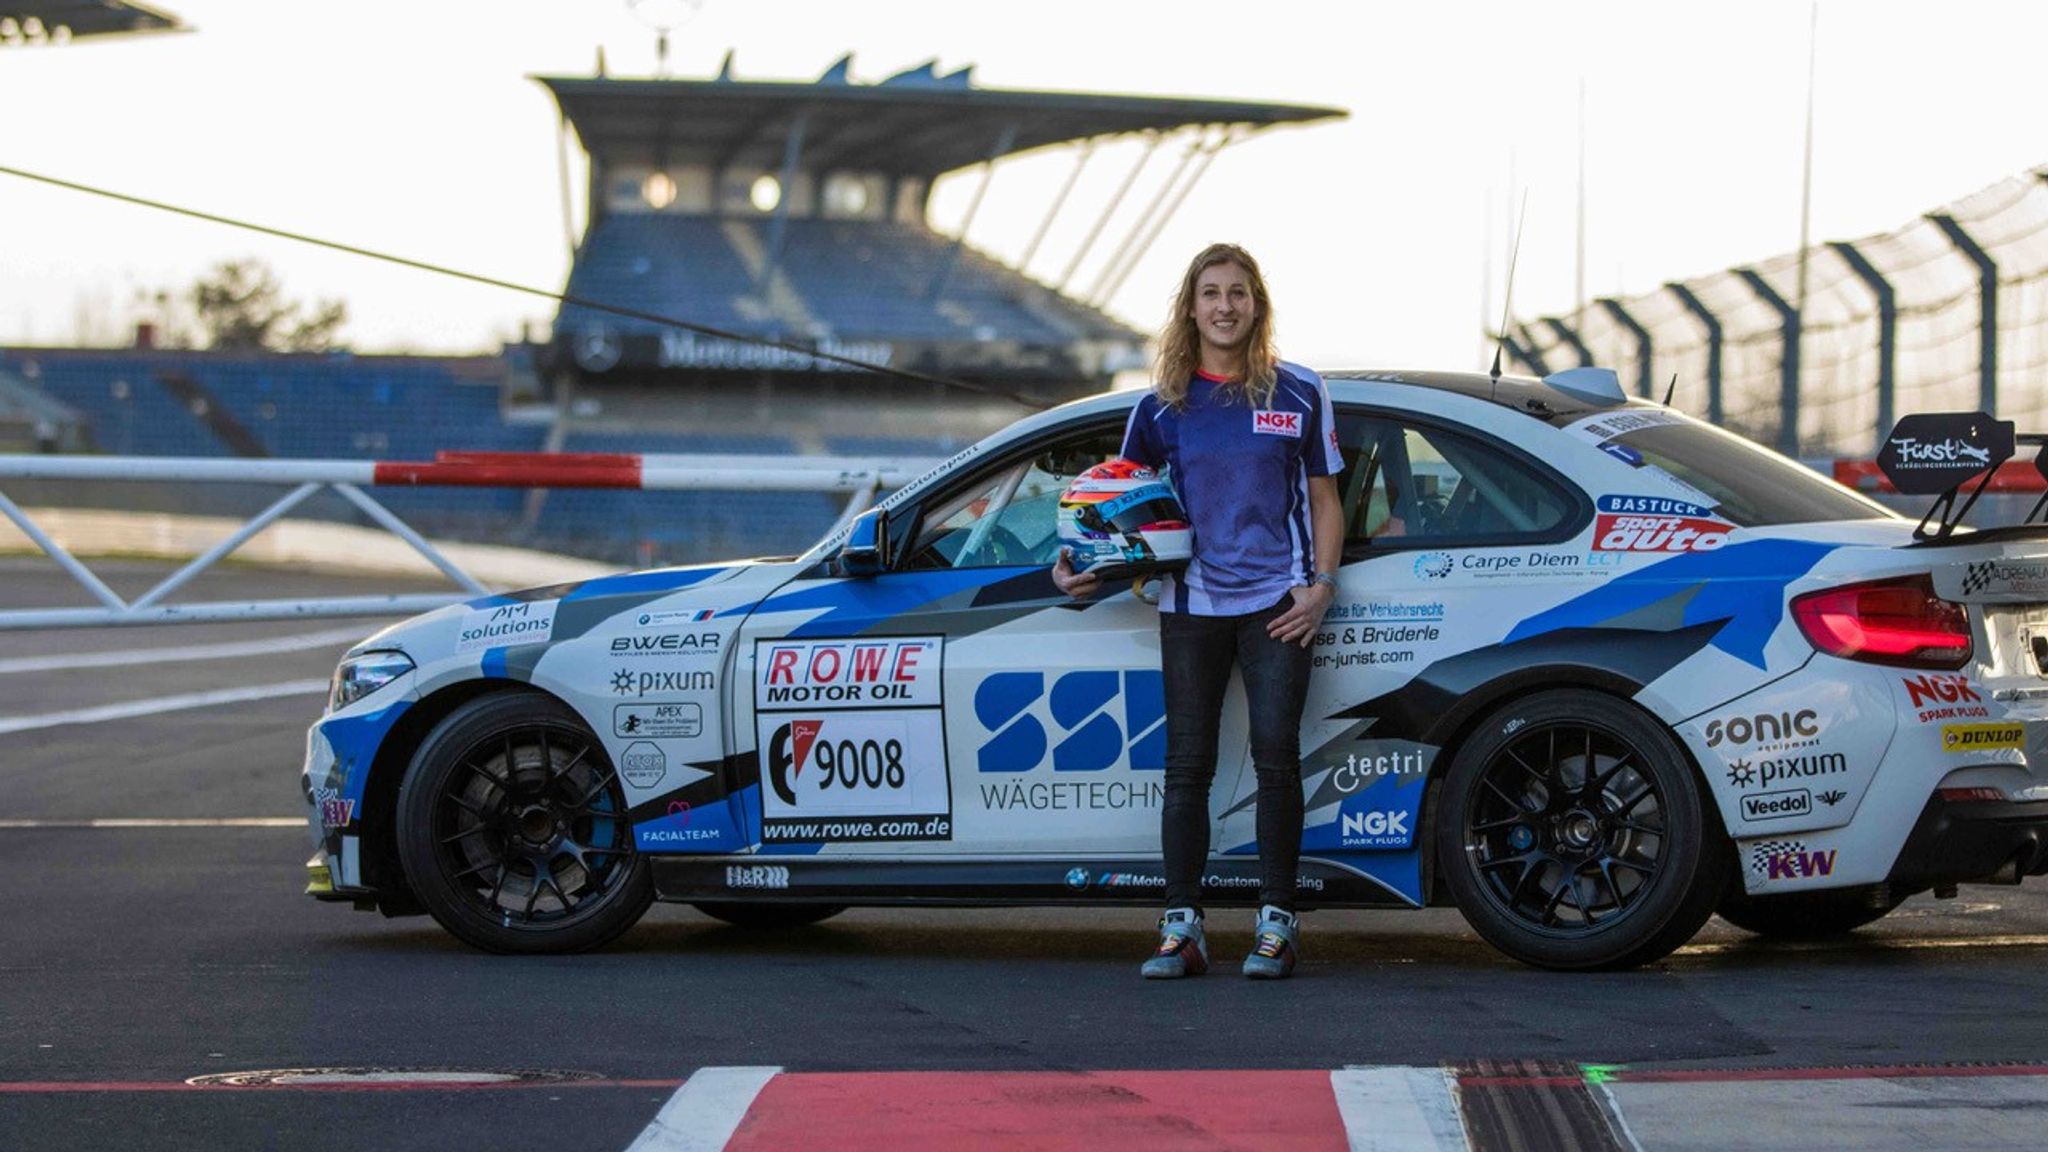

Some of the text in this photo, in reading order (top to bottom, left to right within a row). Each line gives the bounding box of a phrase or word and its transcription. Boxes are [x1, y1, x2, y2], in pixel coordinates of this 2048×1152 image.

[1256, 413, 1298, 430] NGK
[1610, 497, 1697, 515] BASTUCK
[1611, 517, 1683, 531] sport
[1600, 528, 1729, 550] auto
[1462, 552, 1624, 571] Carpe Diem ECT
[1351, 602, 1368, 617] für
[1369, 602, 1445, 617] Verkehrsrecht
[461, 618, 550, 642] solutions
[1315, 625, 1439, 646] se & Brüderle
[611, 633, 721, 651] BWEAR
[767, 644, 925, 685] ROWE
[1313, 650, 1414, 669] er-jurist.com
[639, 671, 715, 697] pixum
[767, 684, 913, 702] MOTOR OIL
[1901, 674, 1982, 708] NGK
[656, 706, 683, 717] APEX
[1919, 707, 1989, 723] SPARK PLUGS
[1961, 729, 2023, 744] DUNLOP
[814, 738, 905, 790] 9008
[1760, 752, 1847, 788] pixum
[980, 778, 1166, 810] WÄGETECHN
[1746, 796, 1807, 815] Veedol
[764, 816, 949, 838] www.rowe.com.de
[1342, 810, 1409, 837] NGK
[643, 830, 720, 842] FACIALTEAM
[1343, 837, 1408, 846] SPARK PLUGS
[1768, 849, 1838, 880] KW
[726, 865, 765, 887] H&R
[1208, 874, 1263, 888] Custom
